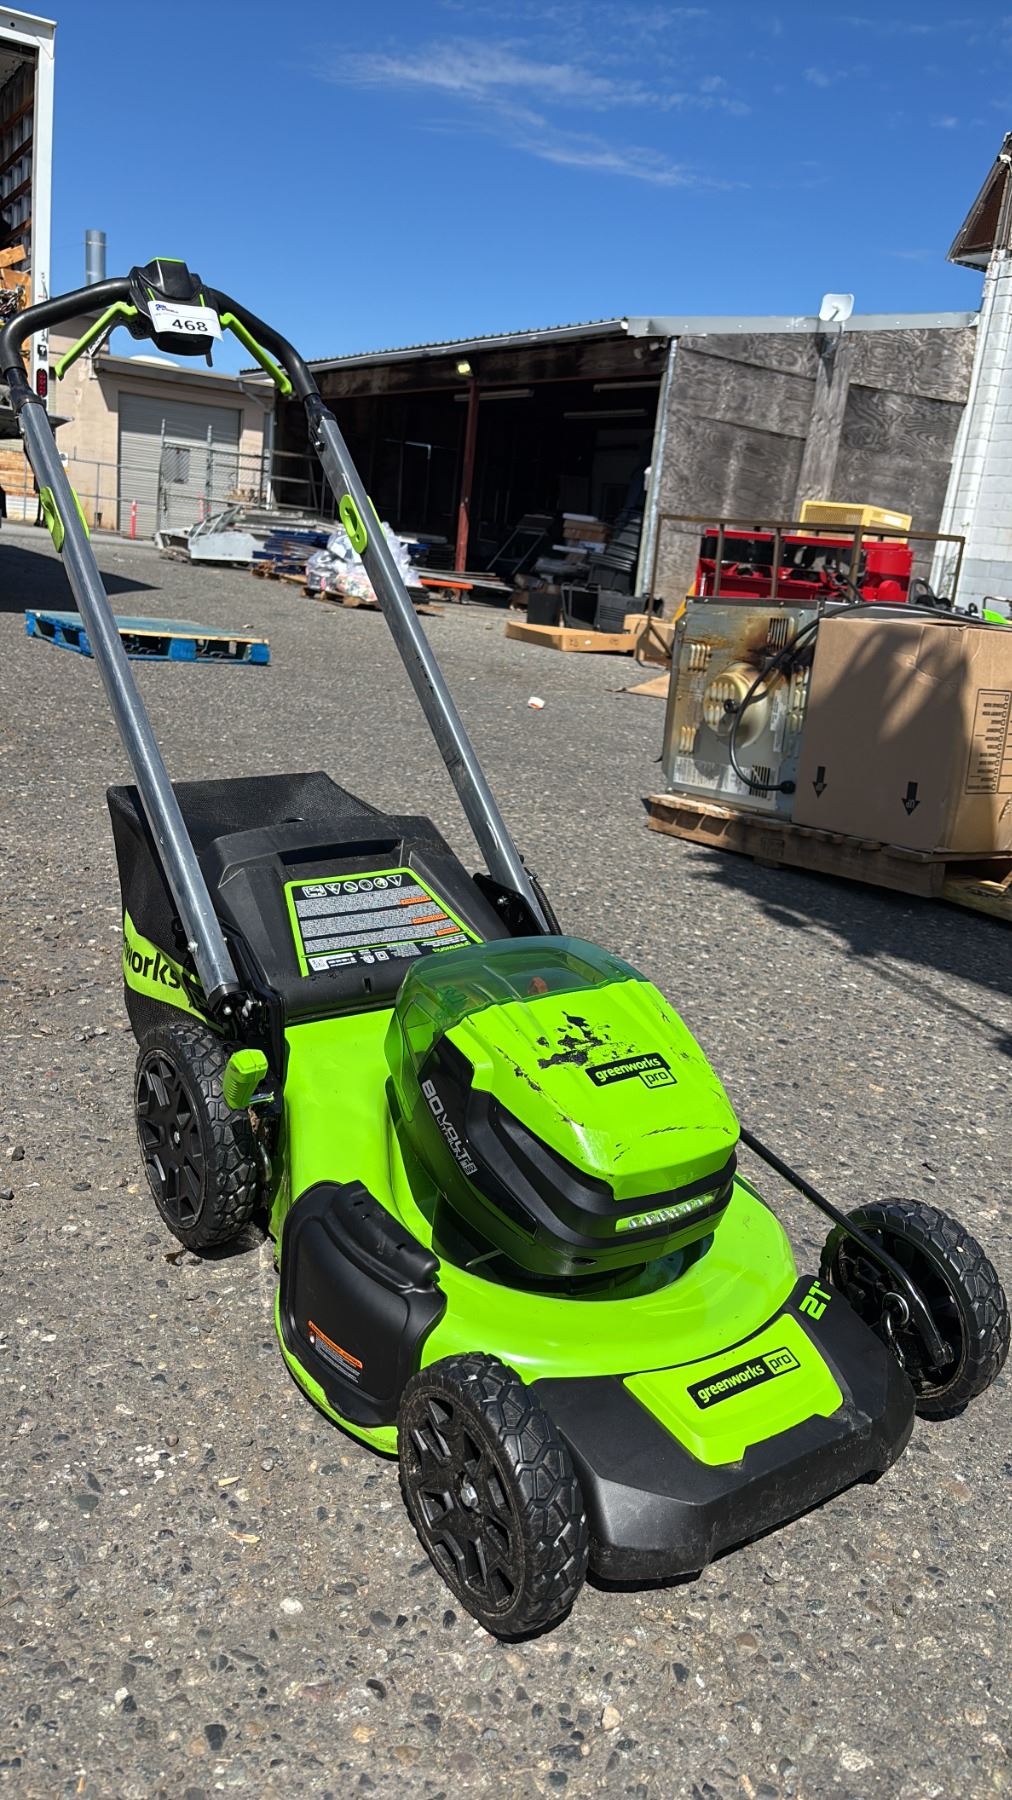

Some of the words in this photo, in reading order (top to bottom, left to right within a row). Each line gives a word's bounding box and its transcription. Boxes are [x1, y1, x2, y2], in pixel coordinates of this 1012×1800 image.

[172, 319, 208, 332] 468
[595, 1057, 661, 1082] greenworks
[645, 1071, 669, 1084] pro
[421, 1079, 444, 1116] 80
[441, 1112, 473, 1160] VOLT
[798, 1281, 832, 1320] 21"
[697, 1363, 765, 1404] greenworks
[768, 1353, 792, 1371] pro
